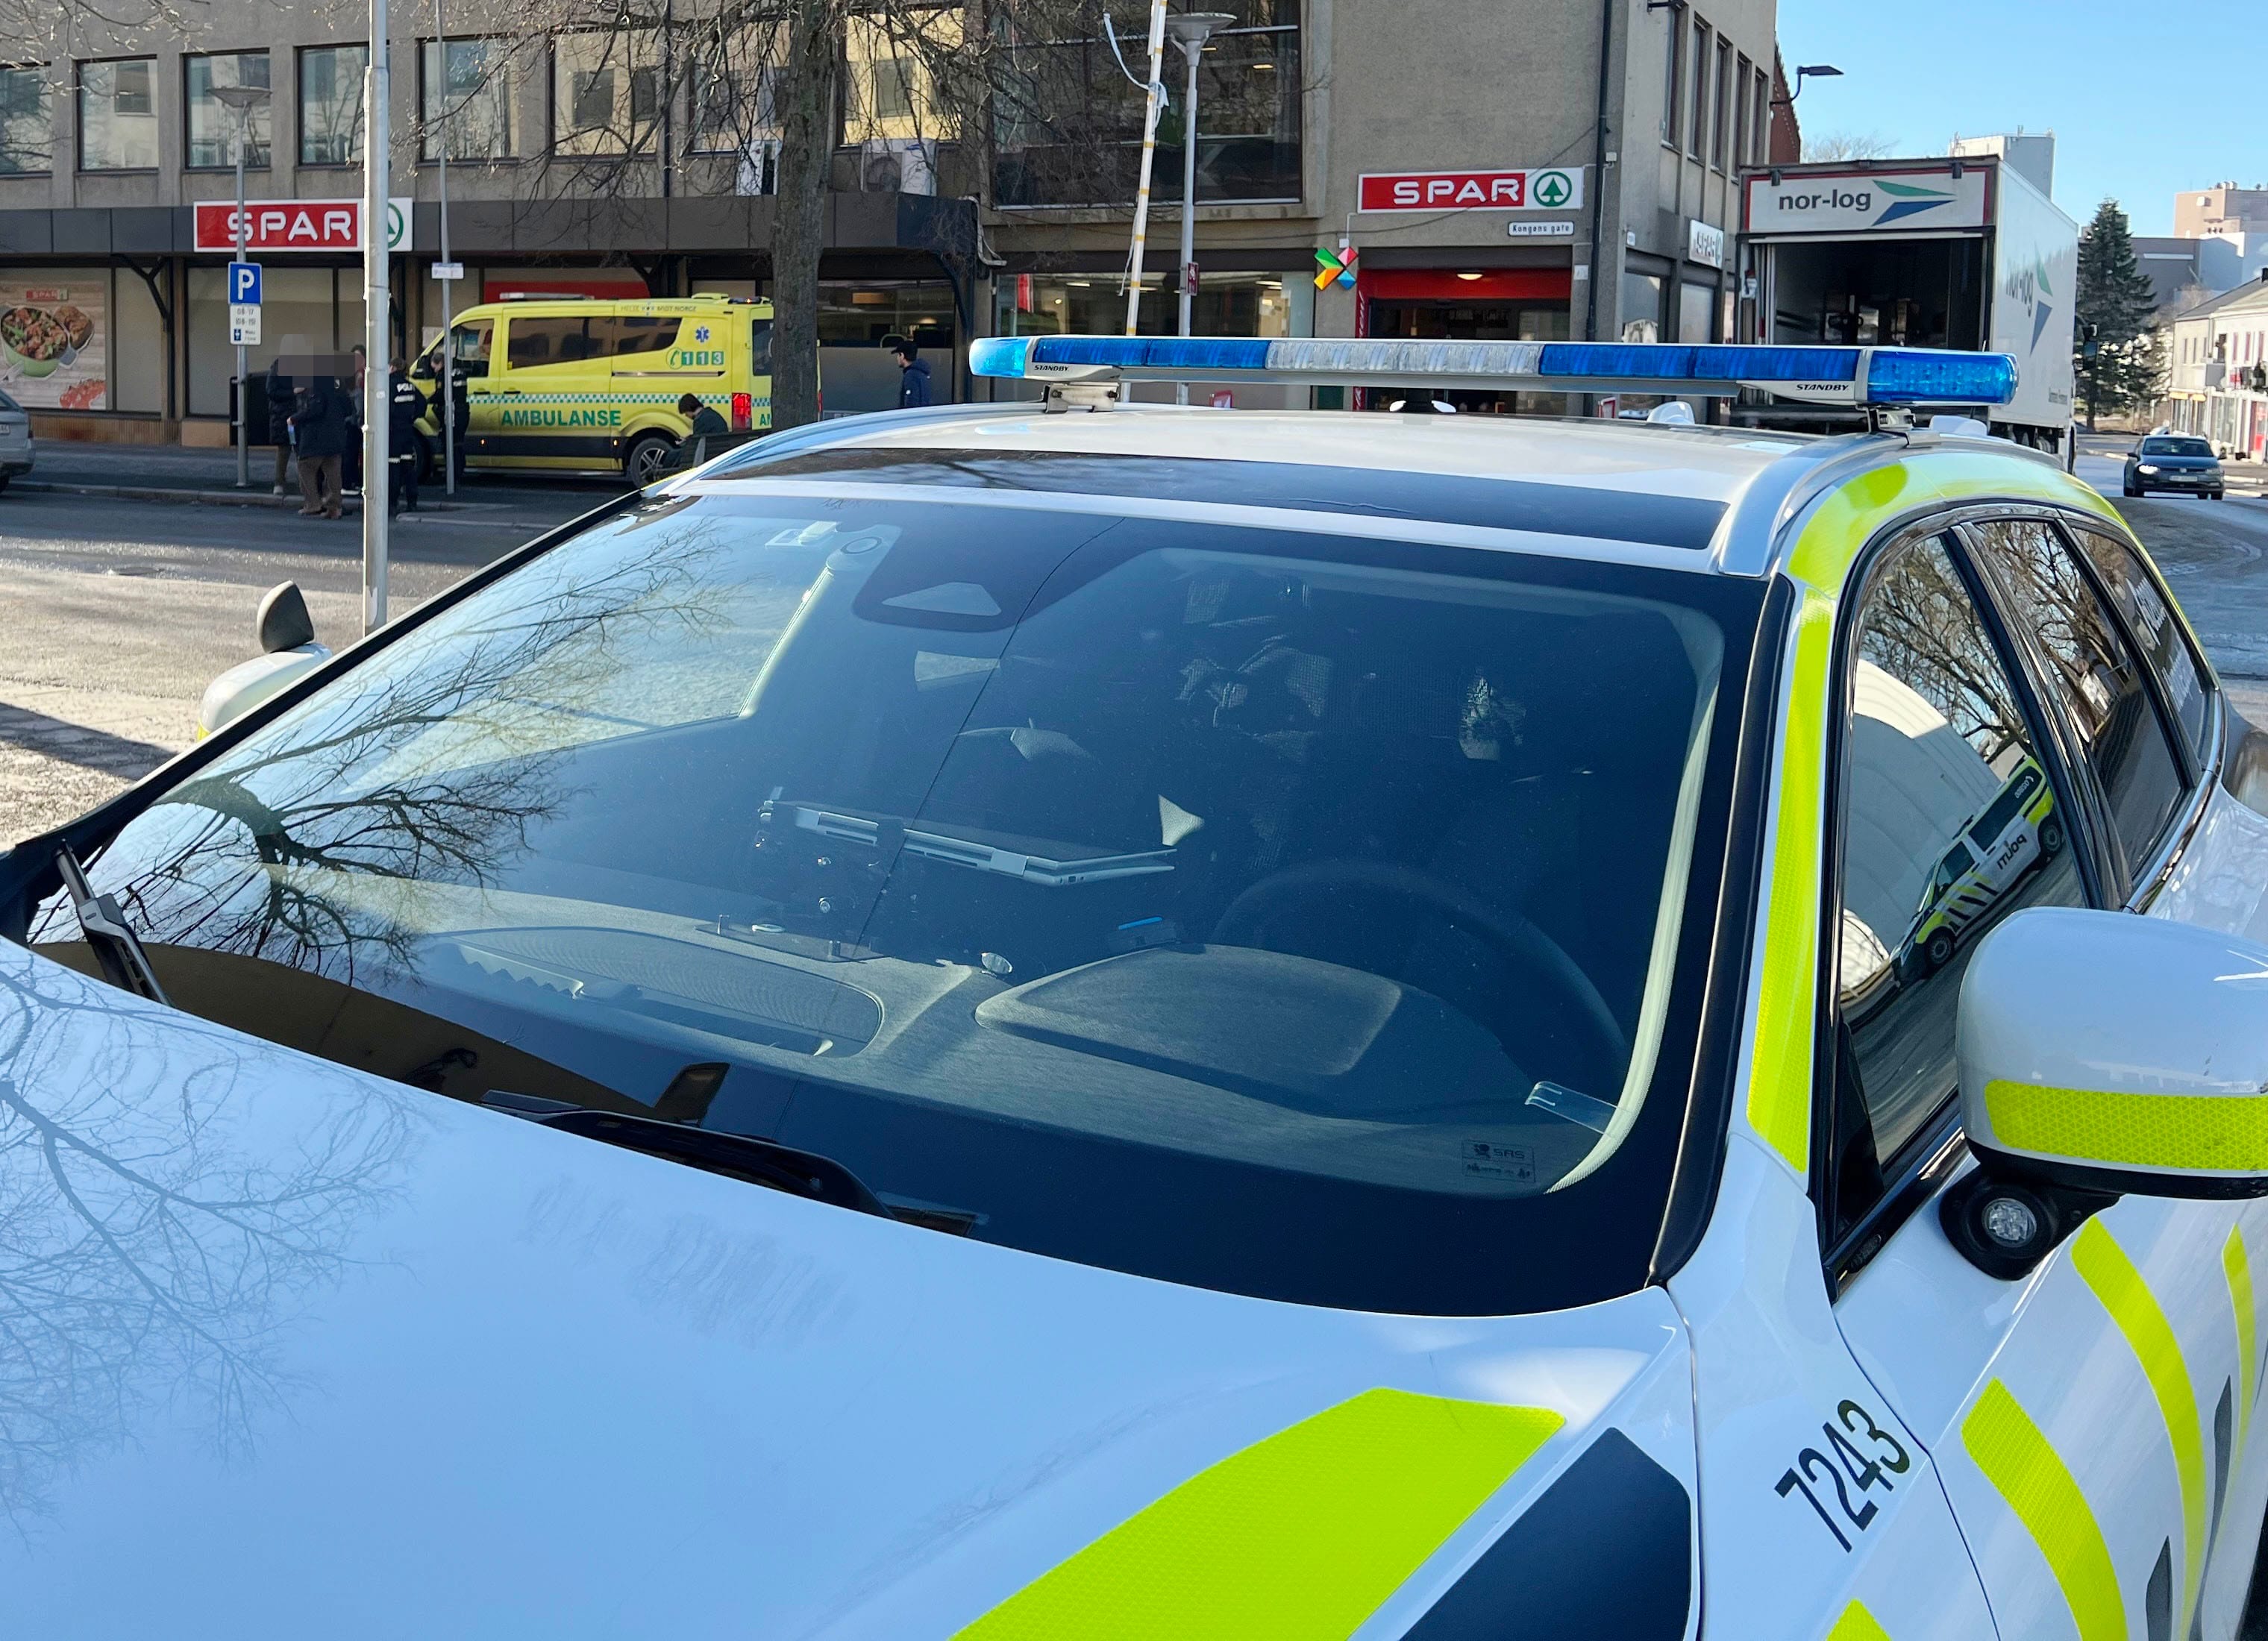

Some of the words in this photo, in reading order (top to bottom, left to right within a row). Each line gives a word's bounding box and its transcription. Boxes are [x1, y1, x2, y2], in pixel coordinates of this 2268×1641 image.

[1394, 178, 1519, 204] SPAR
[1779, 189, 1871, 212] nor-log
[228, 210, 352, 242] SPAR
[237, 269, 254, 300] P
[684, 352, 722, 365] 113
[501, 410, 621, 426] AMBULANSE
[1774, 1399, 1910, 1554] 7243
